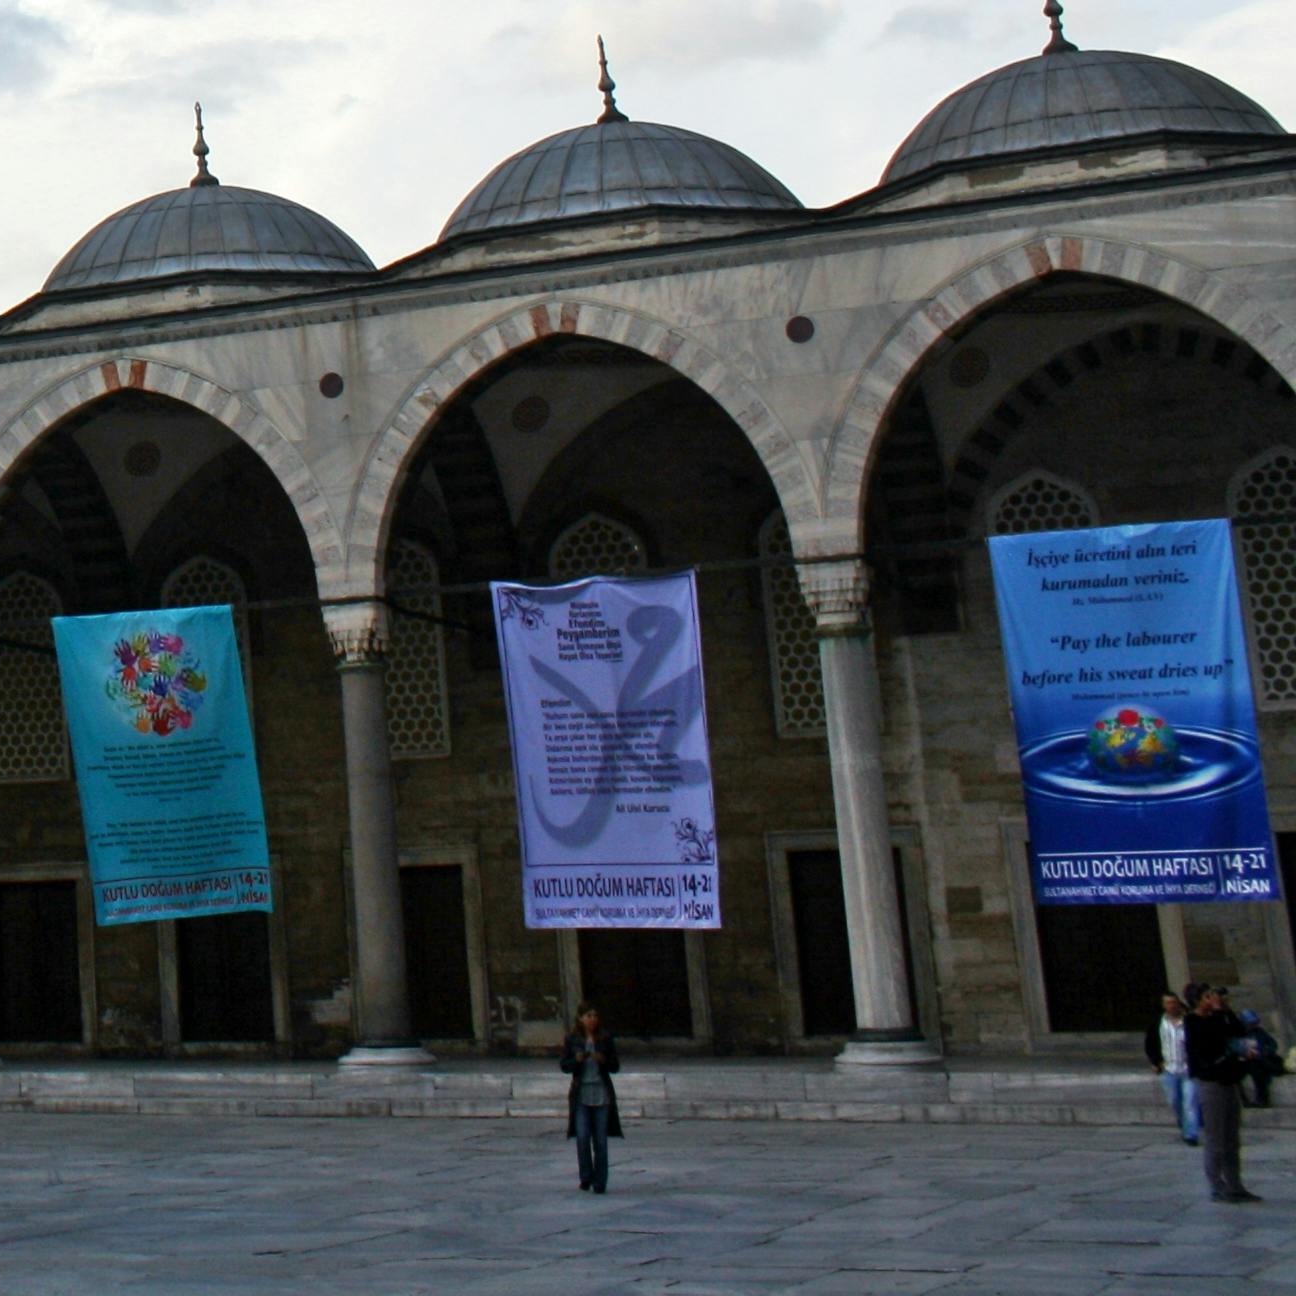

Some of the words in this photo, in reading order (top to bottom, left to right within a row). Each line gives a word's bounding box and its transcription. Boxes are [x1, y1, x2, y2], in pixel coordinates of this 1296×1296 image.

[1027, 548, 1070, 569] İşçiye
[1074, 544, 1132, 563] ücretini
[1136, 542, 1166, 560] alın
[1171, 540, 1198, 555] teri
[1041, 572, 1129, 592] kurumadan
[1095, 632, 1121, 649] the
[1126, 631, 1197, 648] labourer
[1021, 670, 1073, 689] before
[1078, 666, 1102, 683] his
[1107, 665, 1153, 681] sweat
[1158, 661, 1198, 678] dries
[1041, 859, 1088, 879] KUTLU
[1092, 855, 1150, 878] DOĞUM
[1152, 857, 1213, 877] HAFTASI
[1223, 853, 1266, 873] 14-21
[102, 885, 138, 903] KUTLU
[142, 879, 182, 898] DOĞUM
[186, 876, 232, 895] HAFTASI
[533, 877, 573, 899] KUTLU
[576, 873, 623, 898] DOĞUM
[626, 877, 675, 897] HAFTASI
[1226, 875, 1270, 894] NİSAN
[683, 899, 713, 921] NİSAN
